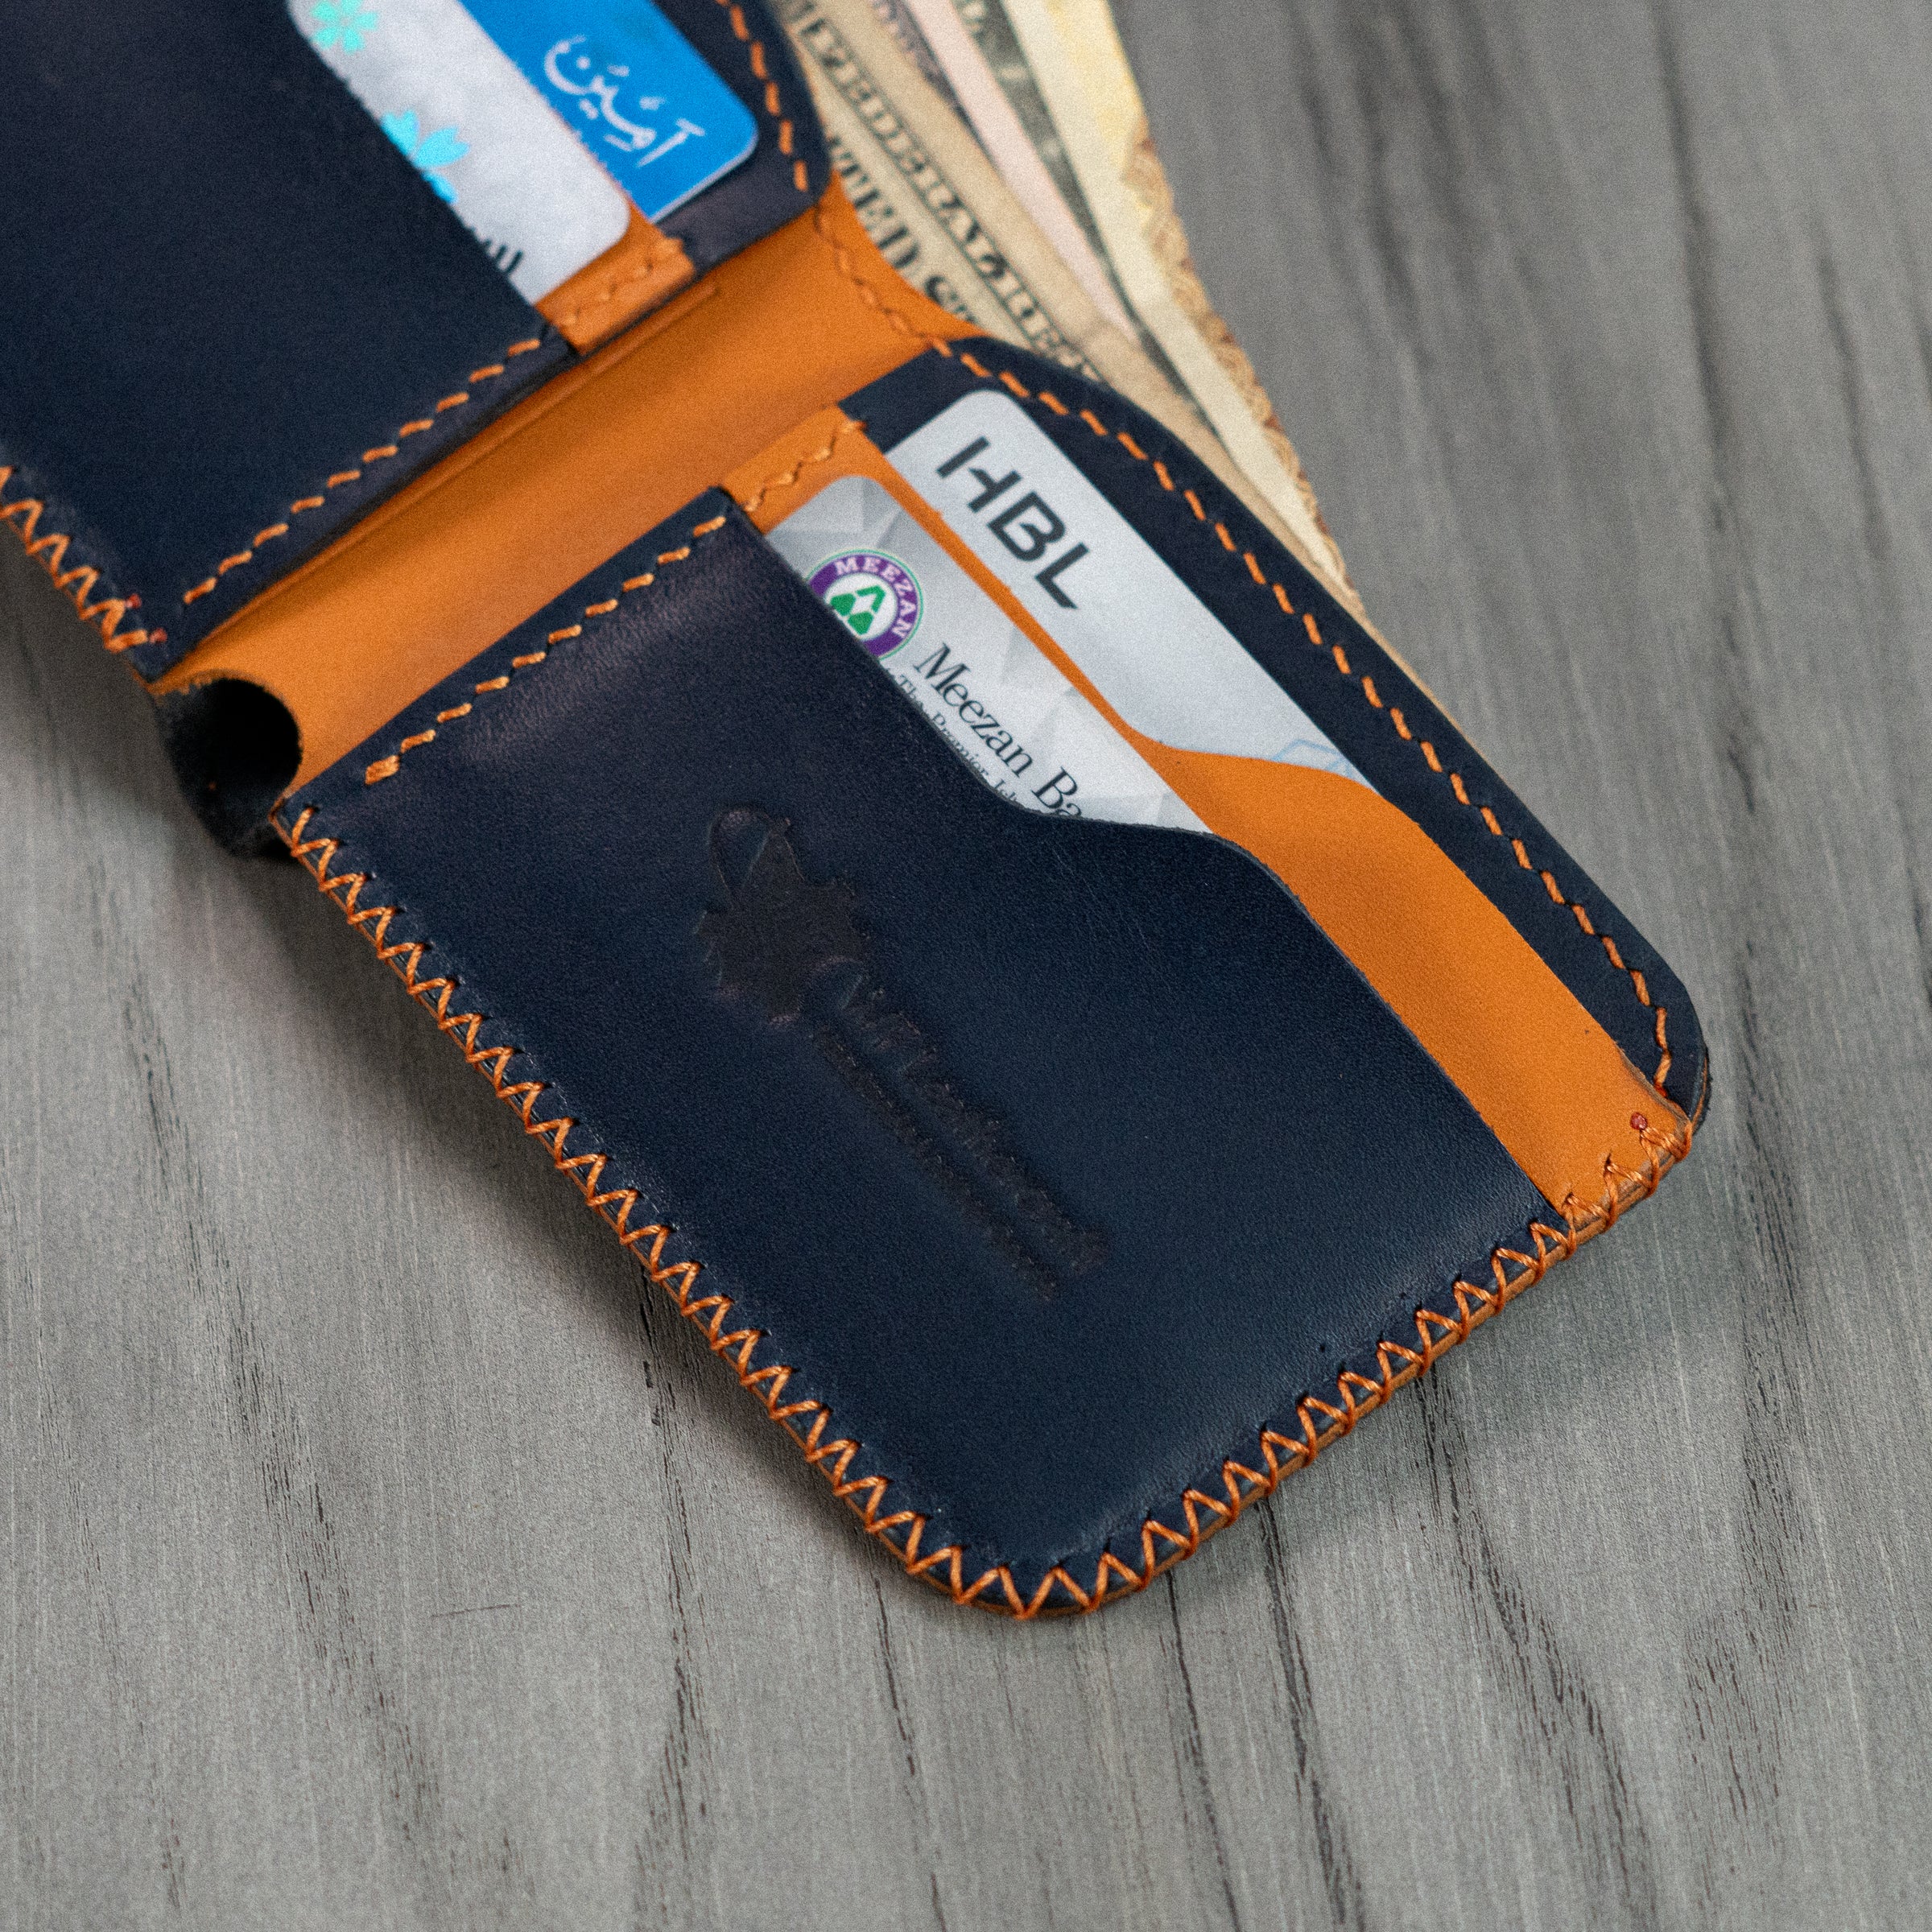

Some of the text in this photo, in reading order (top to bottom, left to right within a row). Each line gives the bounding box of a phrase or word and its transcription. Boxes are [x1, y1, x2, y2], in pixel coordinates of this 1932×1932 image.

[835, 556, 916, 638] MEEZAN
[936, 436, 1090, 609] HBL
[913, 642, 1082, 817] Meezan Ba
